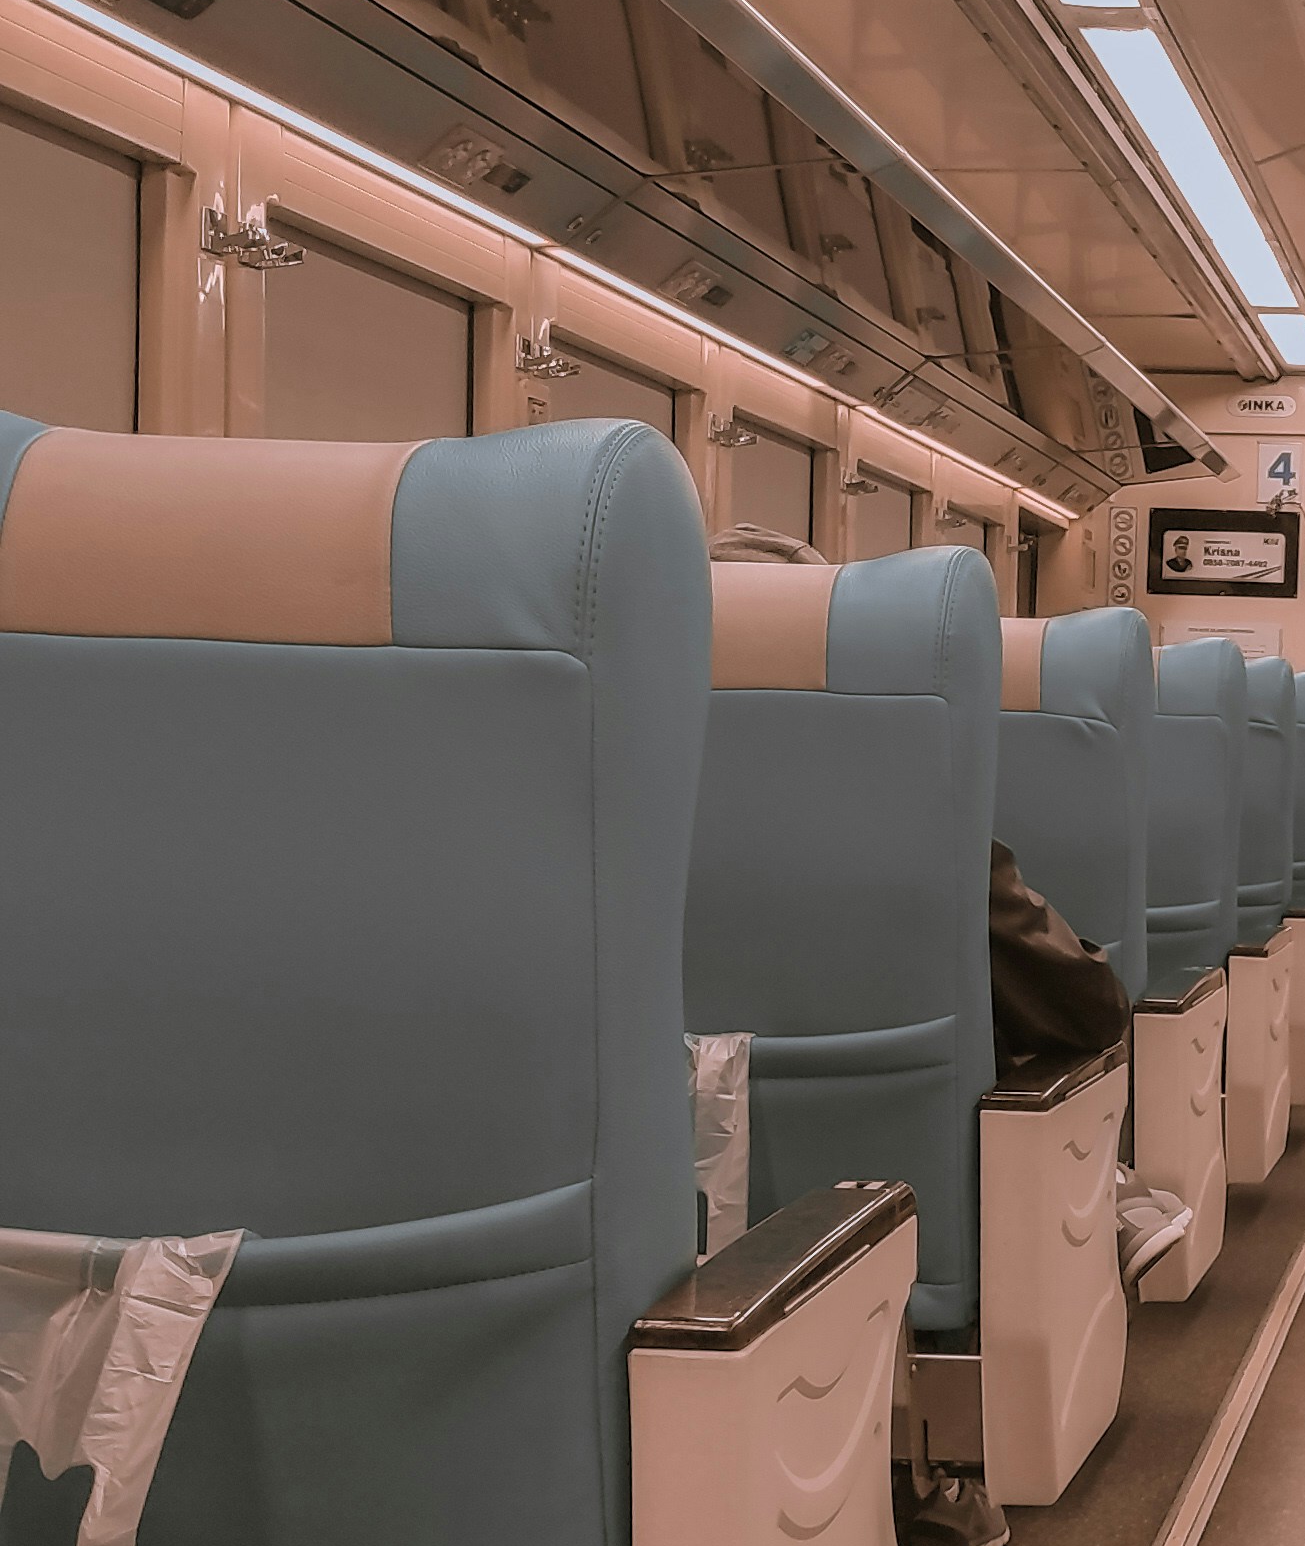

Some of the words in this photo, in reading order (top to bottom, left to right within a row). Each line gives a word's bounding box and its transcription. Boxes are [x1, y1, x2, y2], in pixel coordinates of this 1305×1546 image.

[1247, 399, 1285, 412] INKA
[1267, 452, 1297, 486] 4
[1203, 546, 1241, 557] Krisna
